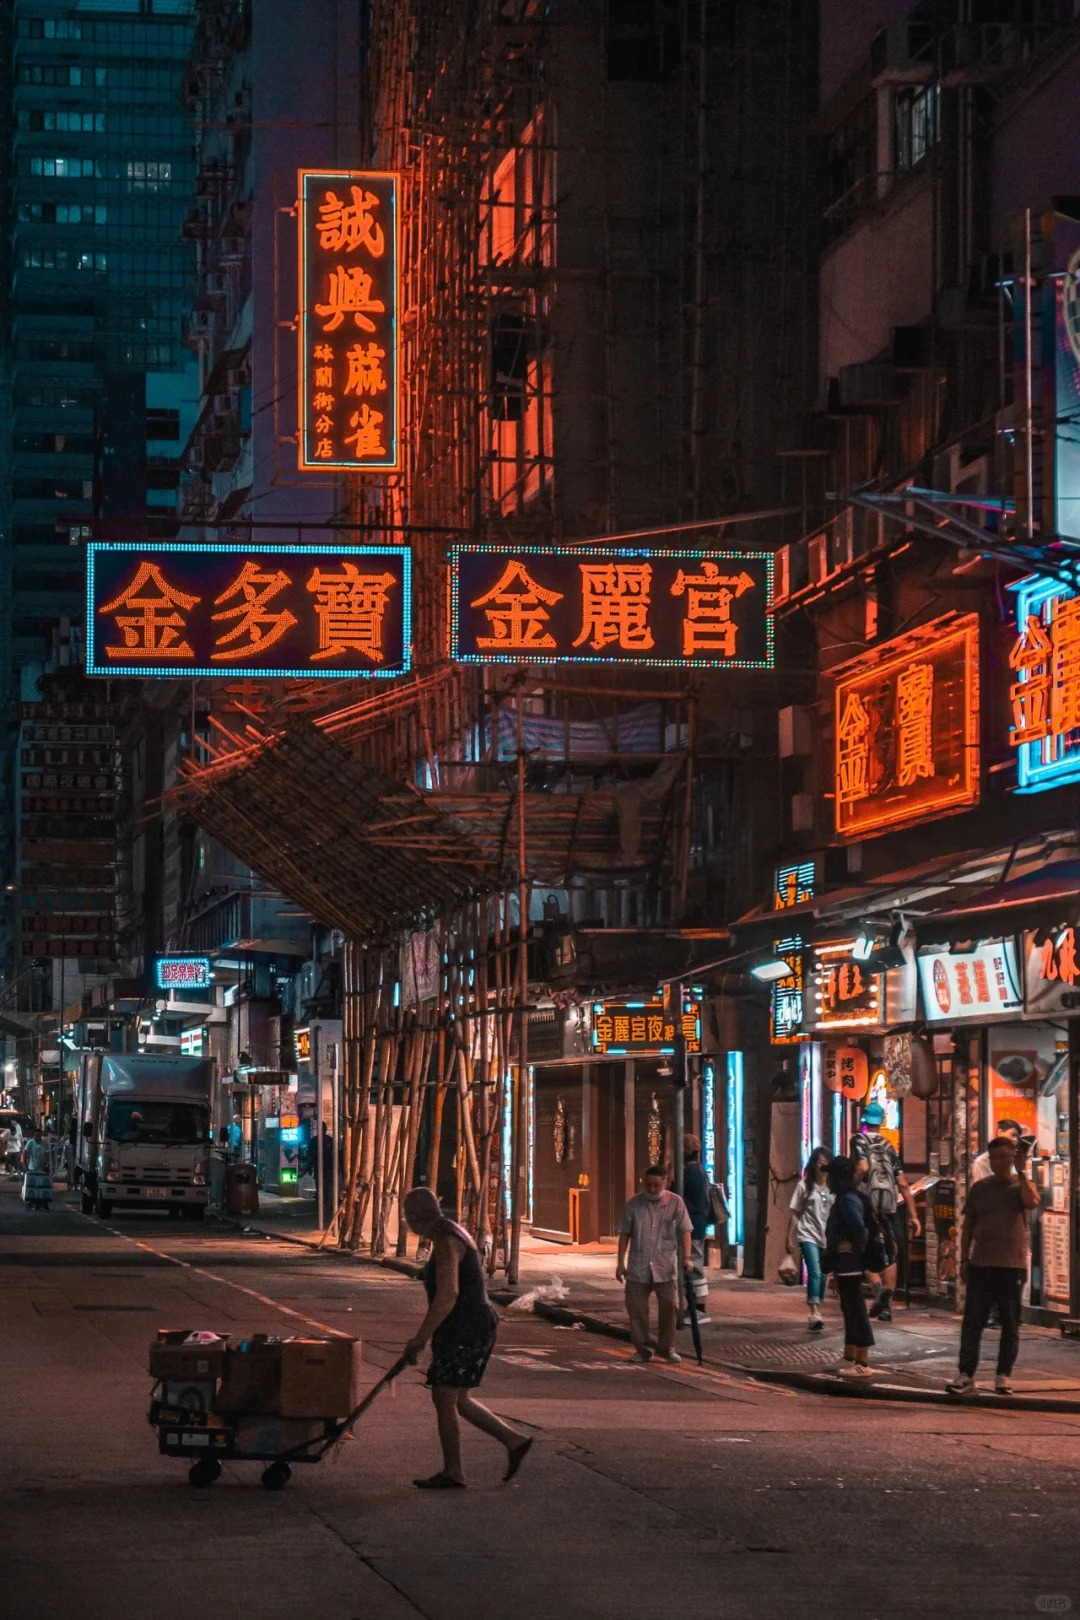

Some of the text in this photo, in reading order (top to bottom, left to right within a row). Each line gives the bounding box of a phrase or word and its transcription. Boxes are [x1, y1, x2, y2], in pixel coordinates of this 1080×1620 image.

[98, 560, 396, 662] 金多寶
[470, 560, 755, 656] 金麗宮
